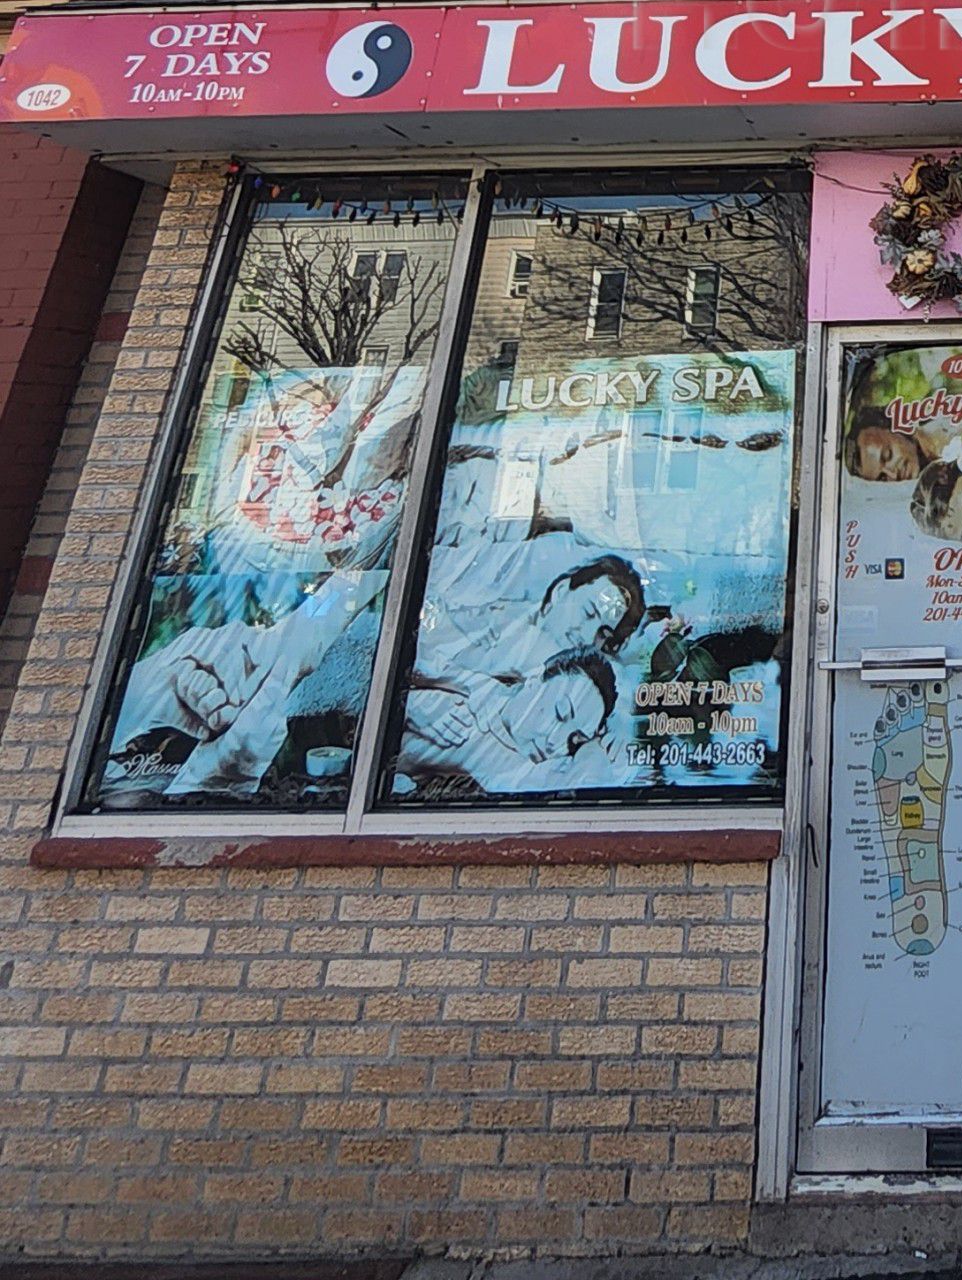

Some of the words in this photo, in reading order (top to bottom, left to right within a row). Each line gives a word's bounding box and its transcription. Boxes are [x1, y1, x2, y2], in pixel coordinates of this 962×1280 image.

[148, 22, 267, 49] OPEN
[124, 55, 143, 79] 7
[164, 51, 272, 78] DAYS
[25, 88, 62, 109] 1042
[128, 81, 246, 105] 10AM-10PM
[495, 370, 660, 411] LUCKY
[671, 366, 765, 402] SPA
[845, 520, 861, 579] PUSH
[636, 681, 693, 707] OPEN
[696, 682, 709, 705] 7
[710, 680, 765, 705] DAYS
[646, 711, 695, 736] 10am
[710, 710, 758, 738] 10pm
[627, 743, 657, 766] Tel:
[659, 741, 766, 766] 201-443-2663
